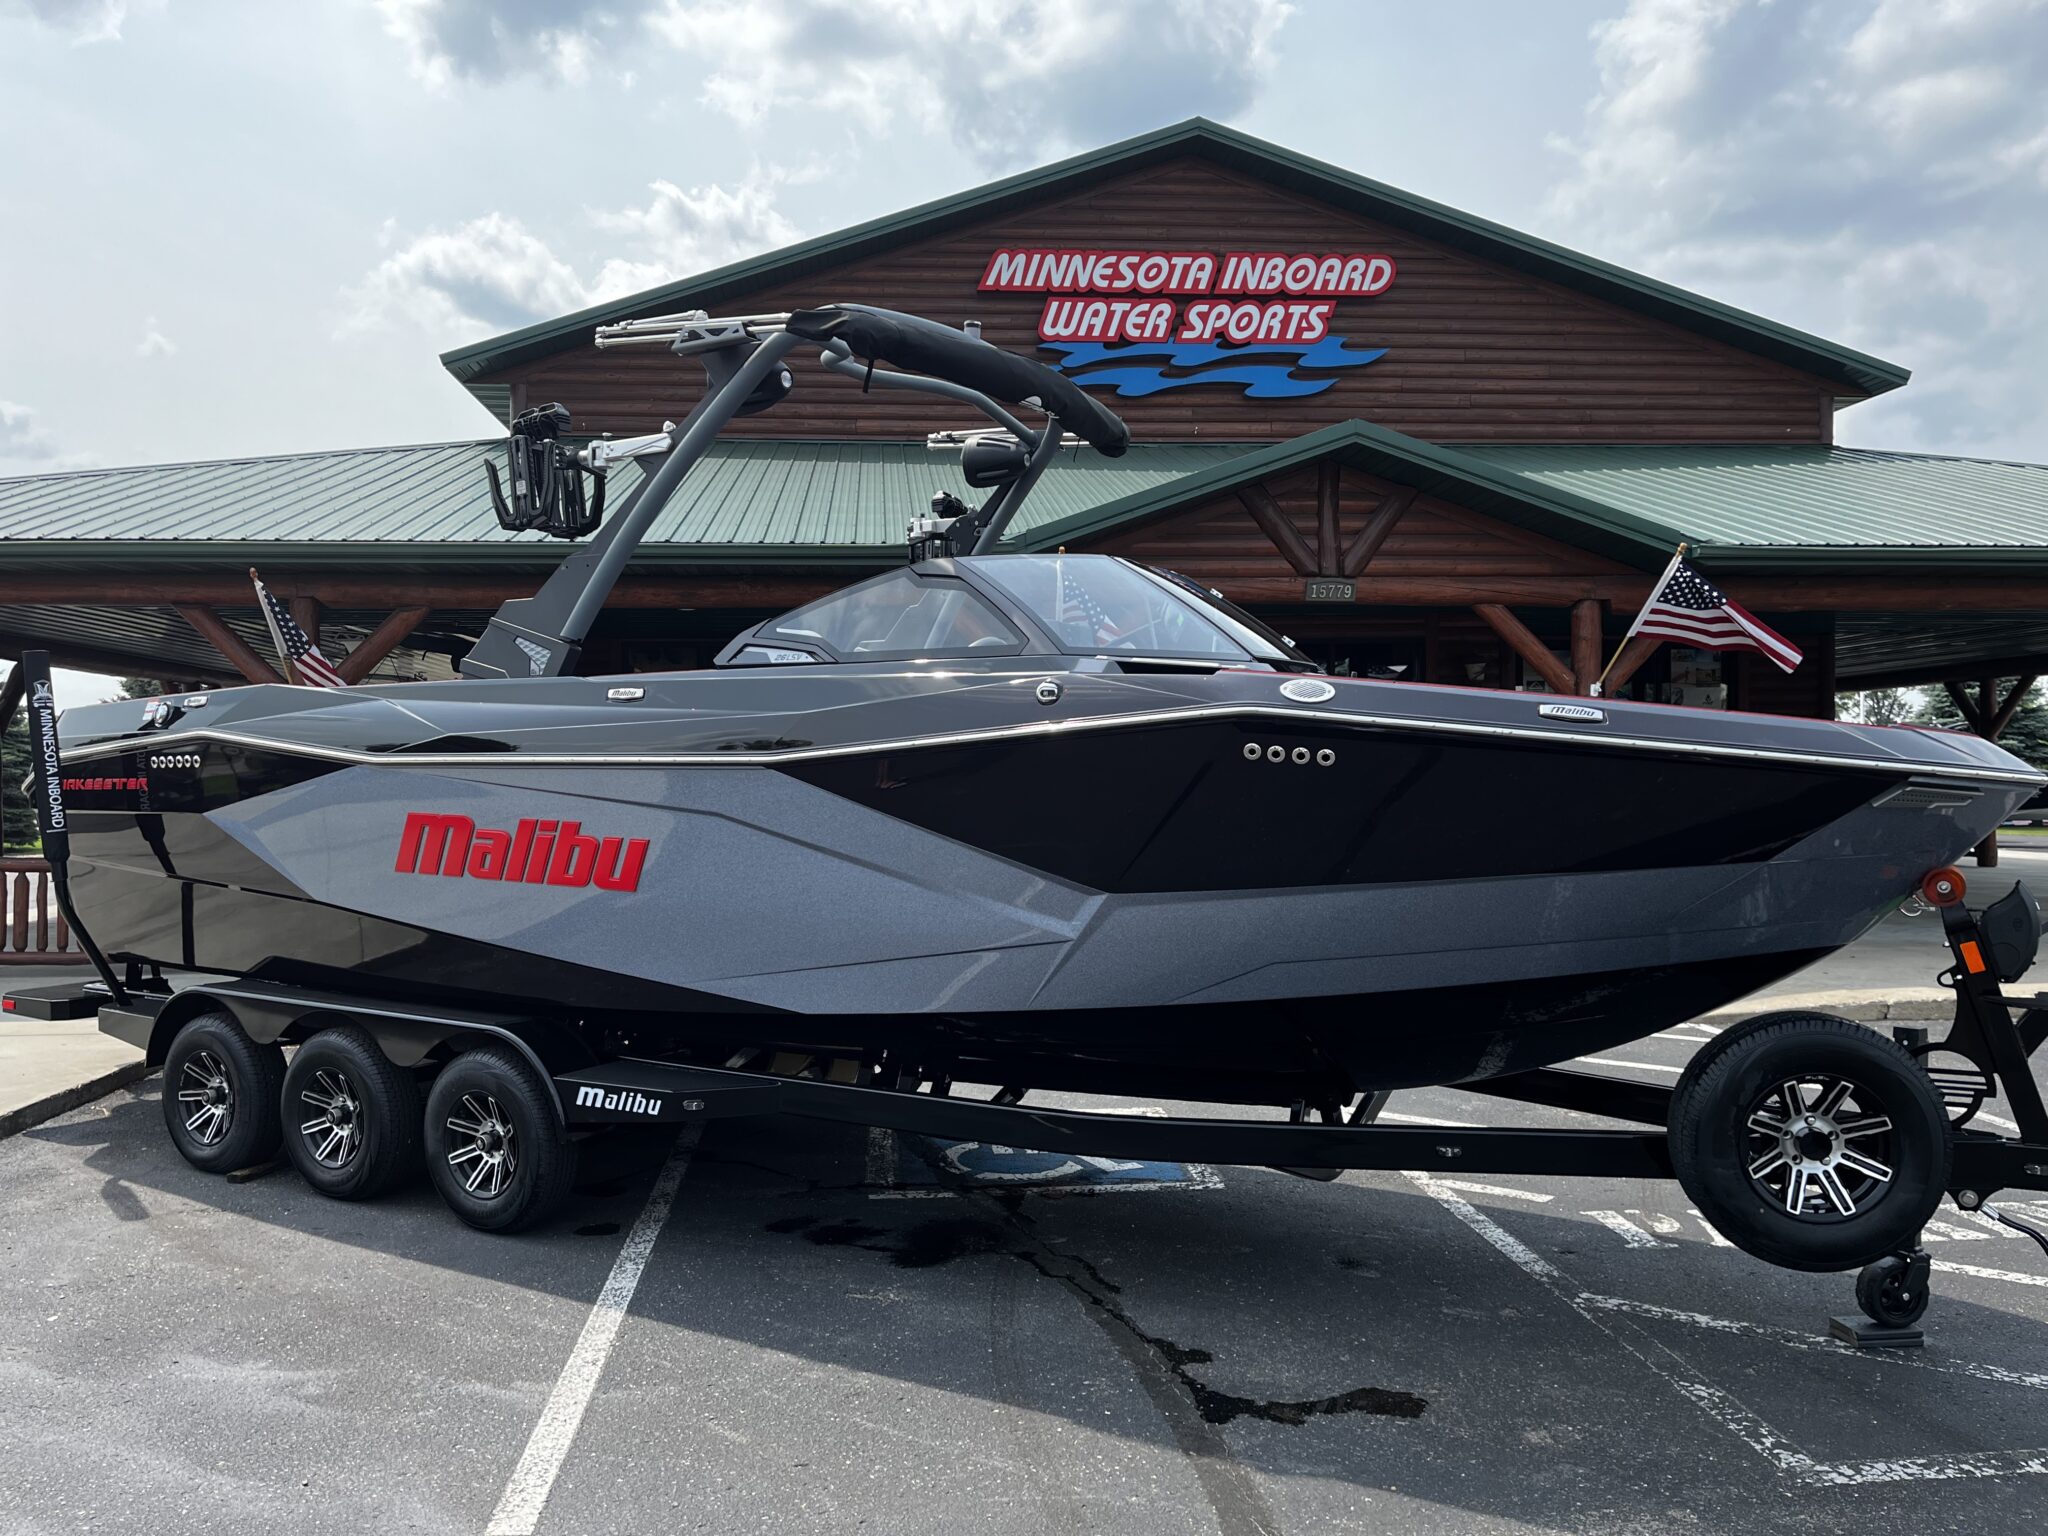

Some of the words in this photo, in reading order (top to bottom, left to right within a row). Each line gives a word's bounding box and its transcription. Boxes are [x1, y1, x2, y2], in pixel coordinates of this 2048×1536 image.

[985, 252, 1213, 290] MINNESOTA
[1220, 254, 1393, 292] INBOARD
[1042, 302, 1170, 338] WATER
[1180, 304, 1330, 340] SPORTS
[1311, 584, 1352, 599] 15779
[1551, 706, 1596, 717] Malibu
[39, 709, 59, 775] MINNESOTA
[46, 776, 65, 828] INBOARD
[395, 812, 650, 892] Malibu
[575, 1086, 662, 1115] Malibu
